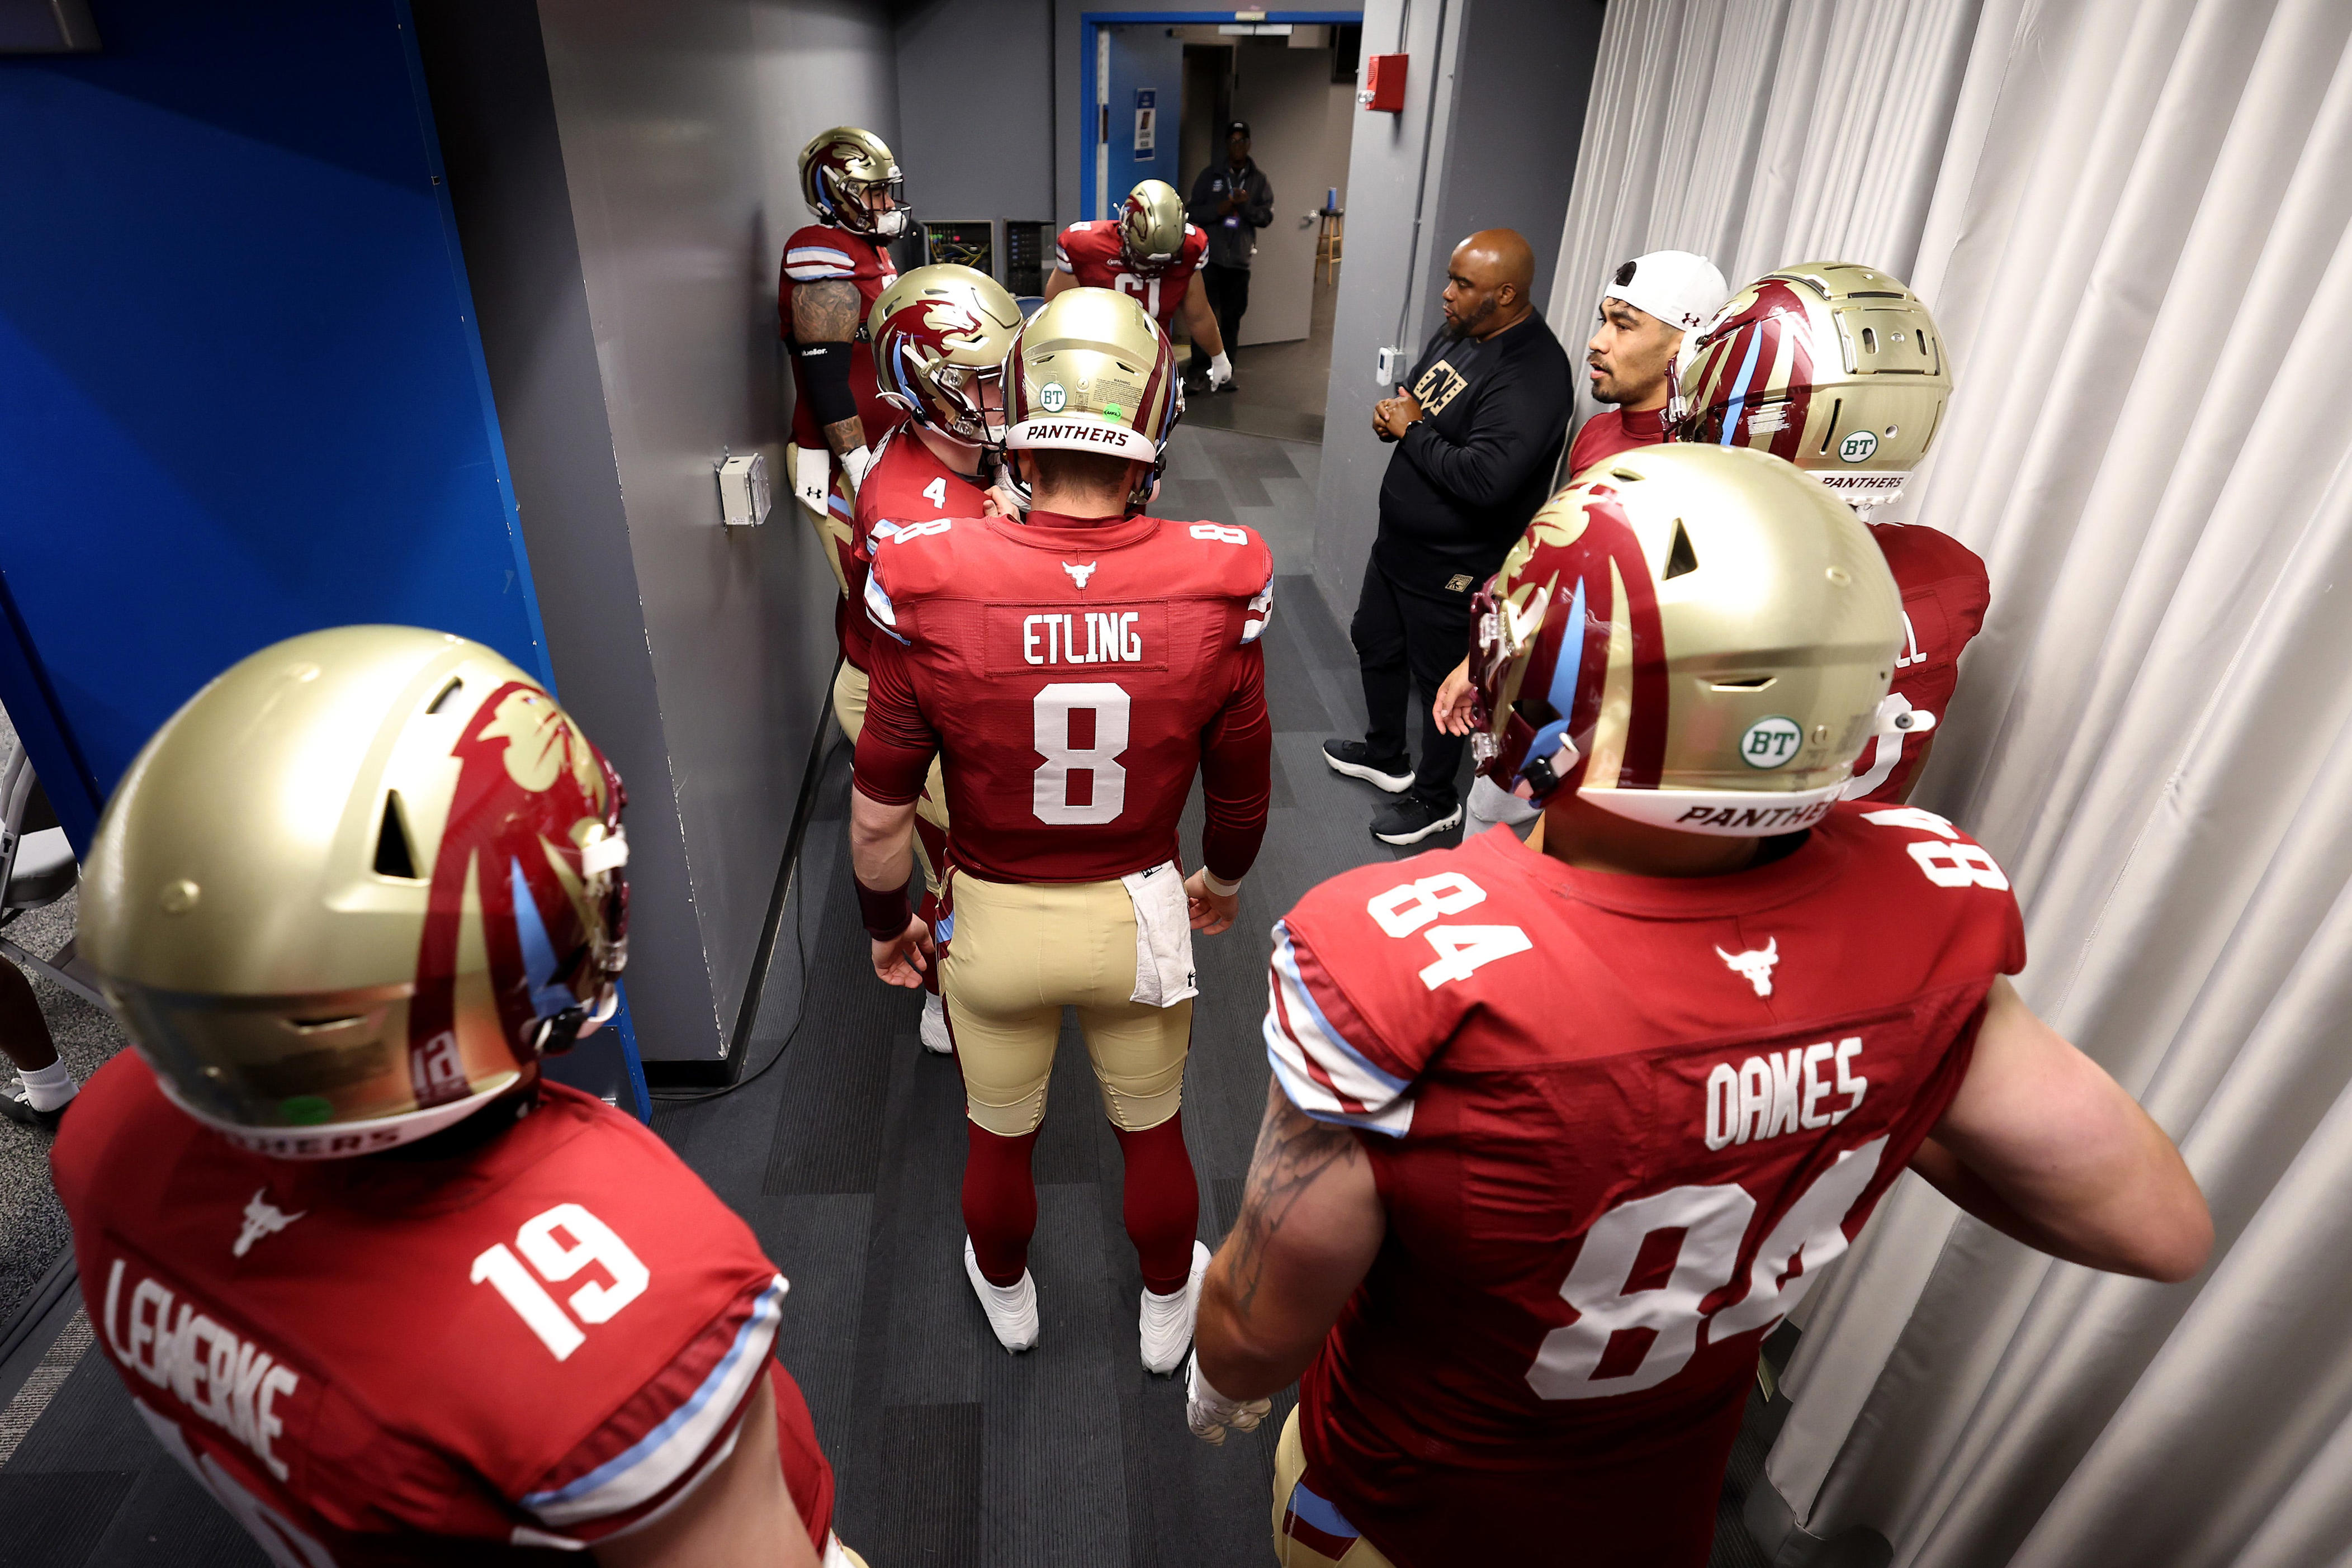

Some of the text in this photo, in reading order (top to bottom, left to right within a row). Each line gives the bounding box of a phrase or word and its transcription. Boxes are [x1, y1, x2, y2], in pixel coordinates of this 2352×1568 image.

[1044, 390, 1062, 404] BT
[1026, 425, 1129, 447] PANTHERS
[1843, 439, 1874, 455] BT
[922, 476, 947, 509] 4
[1823, 477, 1904, 488] PANTHERS
[895, 518, 952, 544] 8
[1190, 524, 1248, 546] 8
[1023, 611, 1142, 665] ETLING
[1033, 682, 1132, 825] 8
[1747, 730, 1795, 757] BT
[1676, 799, 1838, 827] PANTHE
[1366, 871, 1534, 992] 84
[1705, 1036, 1868, 1152] OAKES
[470, 1202, 650, 1362] 19
[1524, 1134, 1890, 1400] 84
[104, 1259, 299, 1482] LEWERKE
